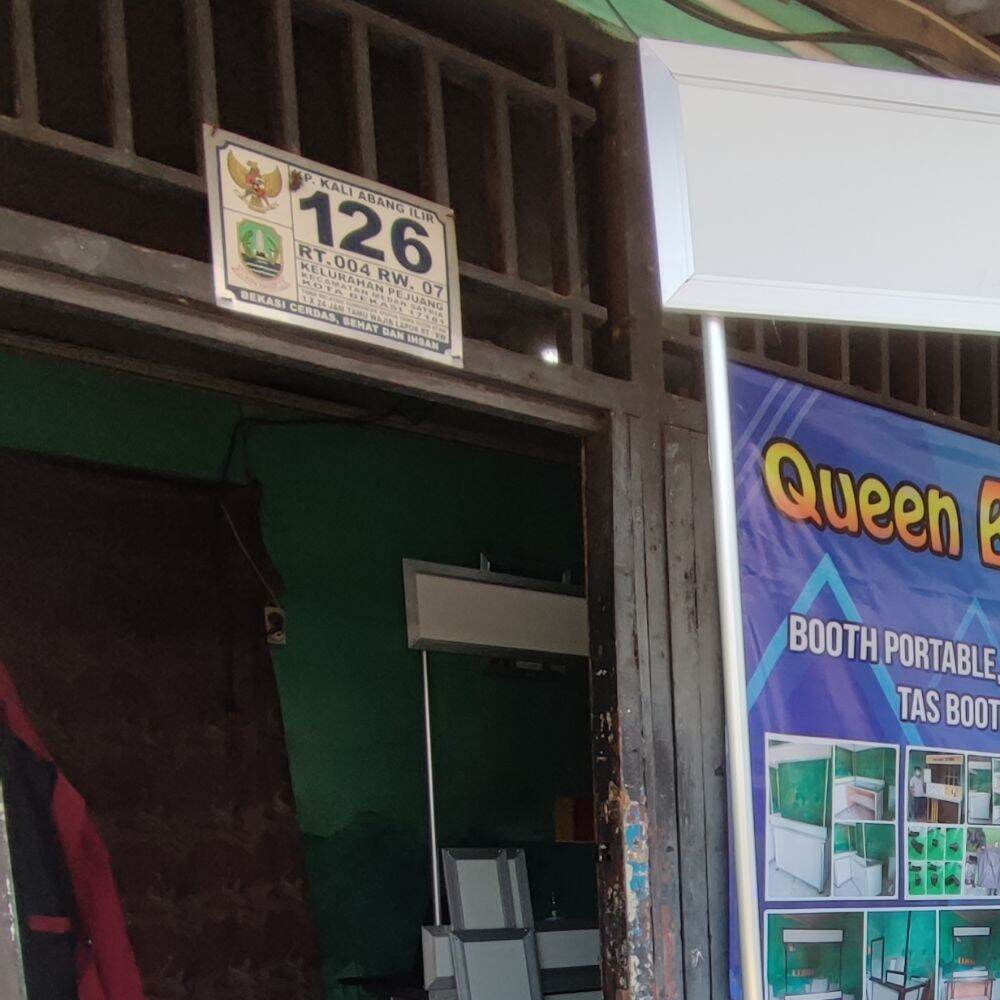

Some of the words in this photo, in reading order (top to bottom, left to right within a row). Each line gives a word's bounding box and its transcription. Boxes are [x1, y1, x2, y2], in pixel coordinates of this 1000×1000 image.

[320, 178, 353, 197] KALI
[358, 191, 405, 214] ABANG
[410, 207, 435, 224] ILIR
[299, 190, 432, 274] 126
[298, 243, 371, 277] RT.004
[378, 267, 414, 290] RW.
[422, 280, 443, 298] 07
[301, 271, 368, 296] KECAMATAN
[301, 261, 384, 293] KELURAHAN
[388, 286, 444, 312] PEJUANG
[302, 278, 343, 296] KOTA
[349, 291, 402, 312] BEKASI
[241, 290, 286, 310] BEKASI
[290, 300, 341, 325] CERDAS,
[343, 312, 379, 334] SEHAT
[382, 326, 406, 340] DAN
[407, 333, 439, 350] IHSAN
[761, 437, 963, 561] Queen
[788, 614, 879, 663] BOOTH
[898, 686, 941, 724] TAS
